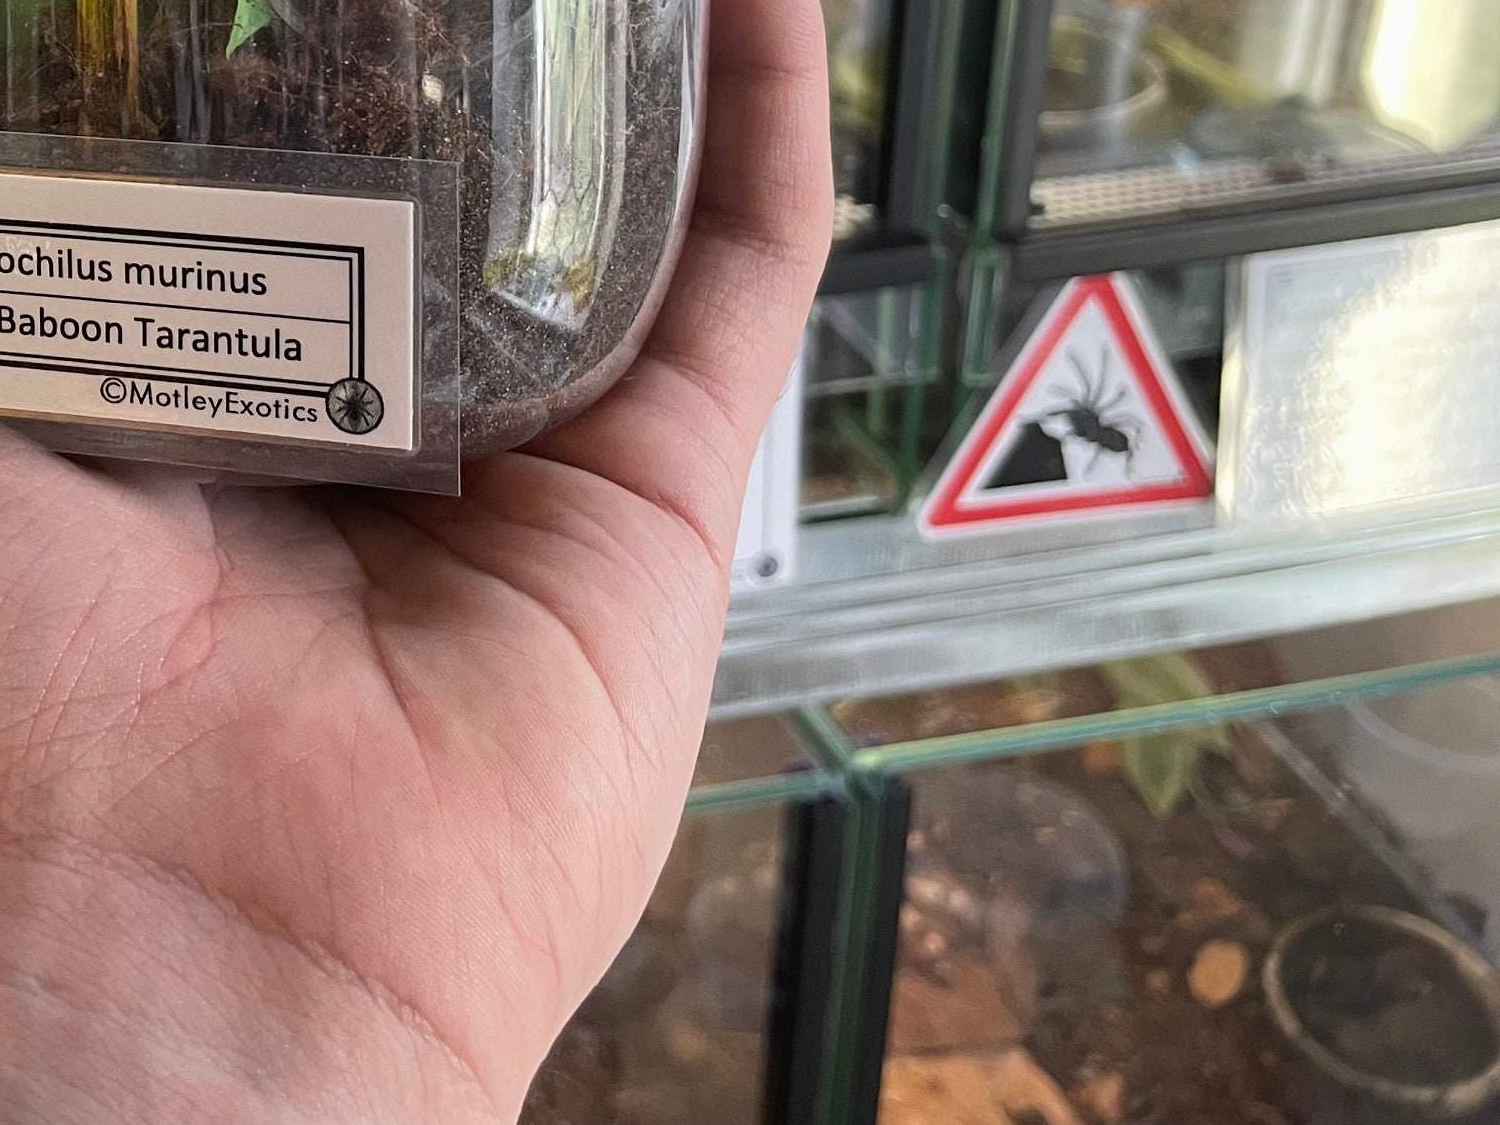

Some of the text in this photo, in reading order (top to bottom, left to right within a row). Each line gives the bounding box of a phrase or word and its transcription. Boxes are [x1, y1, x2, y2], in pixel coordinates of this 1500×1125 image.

[123, 259, 268, 298] murinus
[133, 317, 303, 363] Tarantula
[99, 377, 318, 426] ©MotleyExotics
